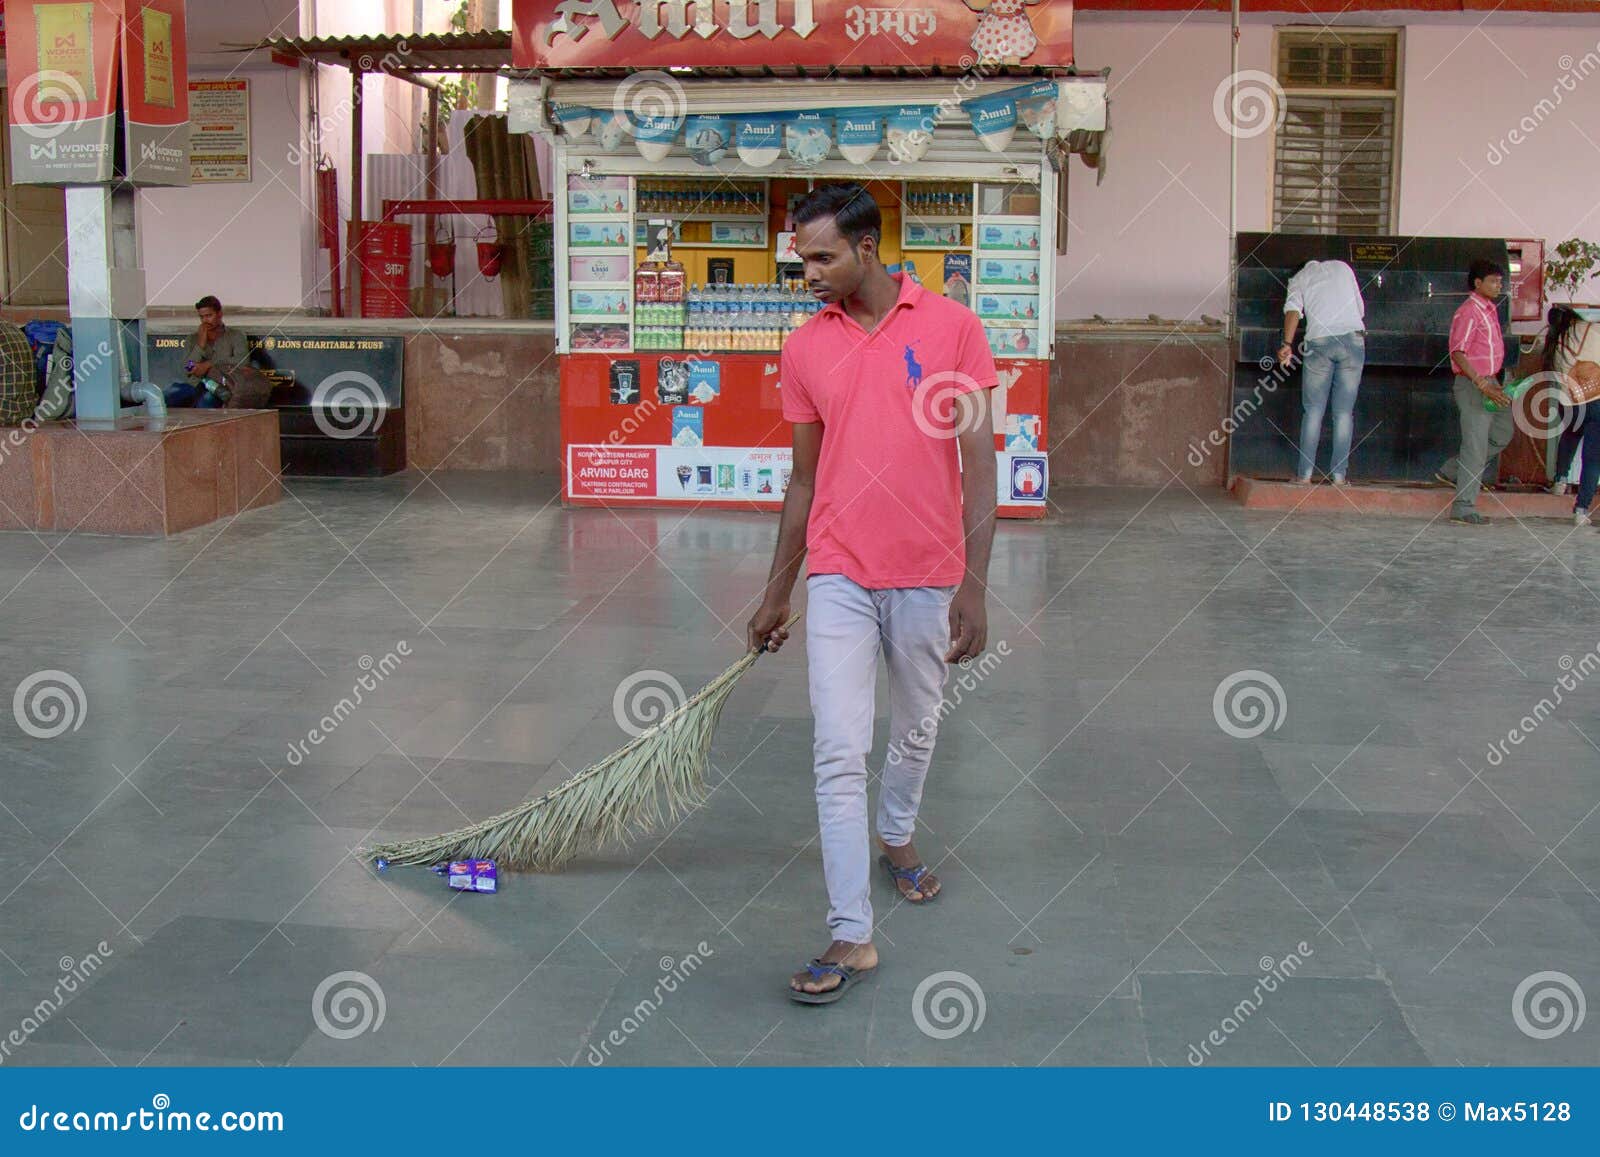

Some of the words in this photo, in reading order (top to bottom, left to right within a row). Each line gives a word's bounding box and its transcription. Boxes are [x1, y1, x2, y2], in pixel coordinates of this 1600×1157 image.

[845, 5, 937, 45] अमूल
[1032, 83, 1054, 95] Amul
[900, 108, 921, 116] Amul
[978, 105, 1012, 121] Amul
[643, 118, 675, 131] Amul
[743, 124, 775, 134] Amul
[843, 120, 876, 132] Amul
[59, 143, 109, 153] WONDER
[156, 339, 179, 348] LIONS
[277, 341, 301, 349] LIONS
[302, 341, 355, 350] CHARITABLE
[357, 341, 384, 350] TRUST
[677, 410, 699, 418] Amul
[580, 468, 617, 478] ARVIND
[619, 468, 649, 479] GARG
